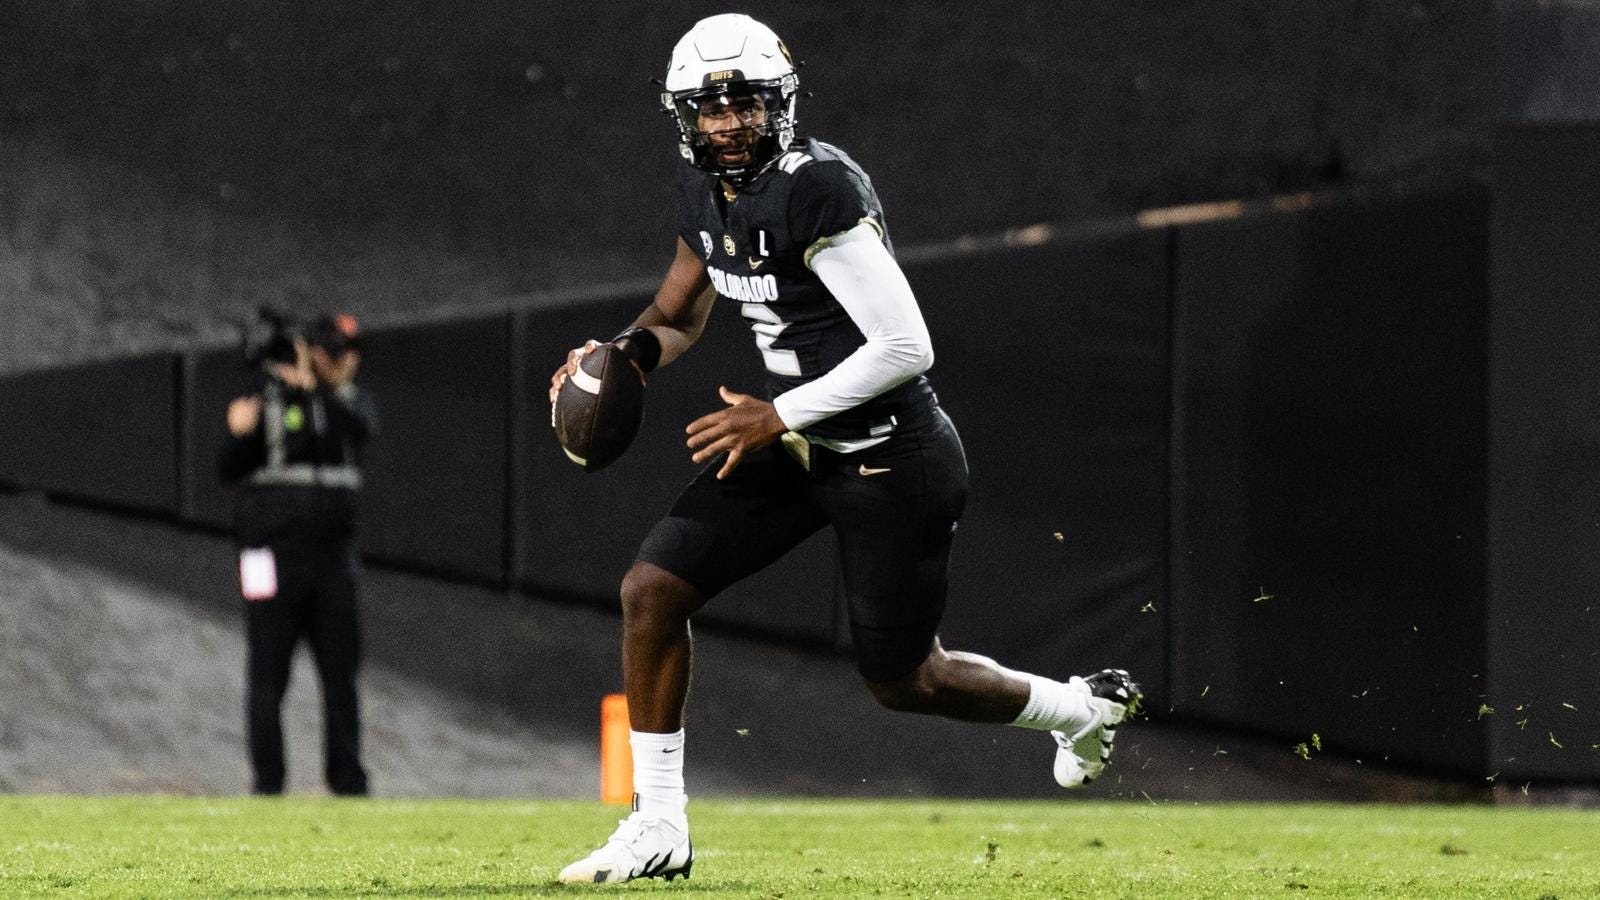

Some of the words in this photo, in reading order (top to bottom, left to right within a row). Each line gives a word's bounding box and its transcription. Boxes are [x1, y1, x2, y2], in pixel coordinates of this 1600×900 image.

[710, 70, 733, 80] BUFFS
[778, 152, 814, 175] 2
[759, 230, 769, 257] L
[741, 303, 802, 376] 2
